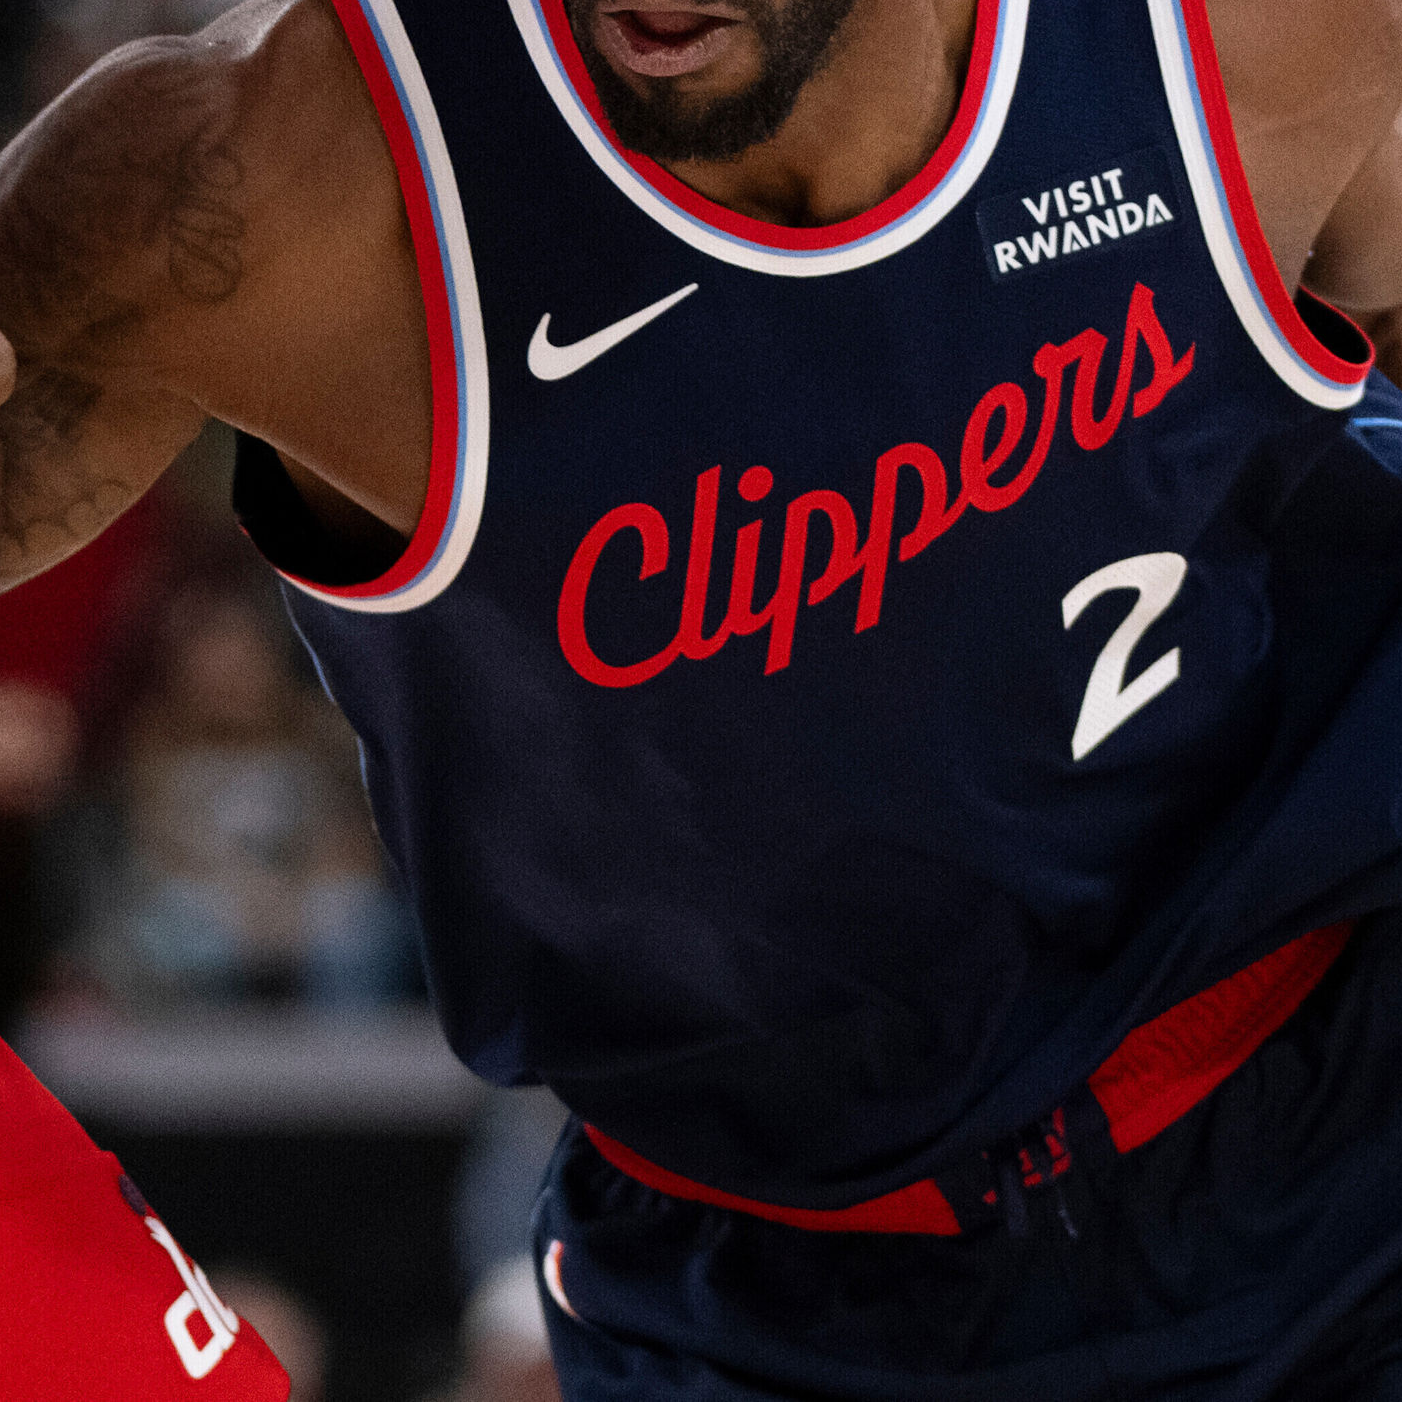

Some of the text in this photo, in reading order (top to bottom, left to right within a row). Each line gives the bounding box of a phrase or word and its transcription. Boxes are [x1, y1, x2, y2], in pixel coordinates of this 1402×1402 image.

[994, 194, 1174, 274] RWANDA
[1021, 168, 1123, 225] VISIT
[557, 281, 1196, 688] Clippers
[1062, 551, 1188, 762] 2
